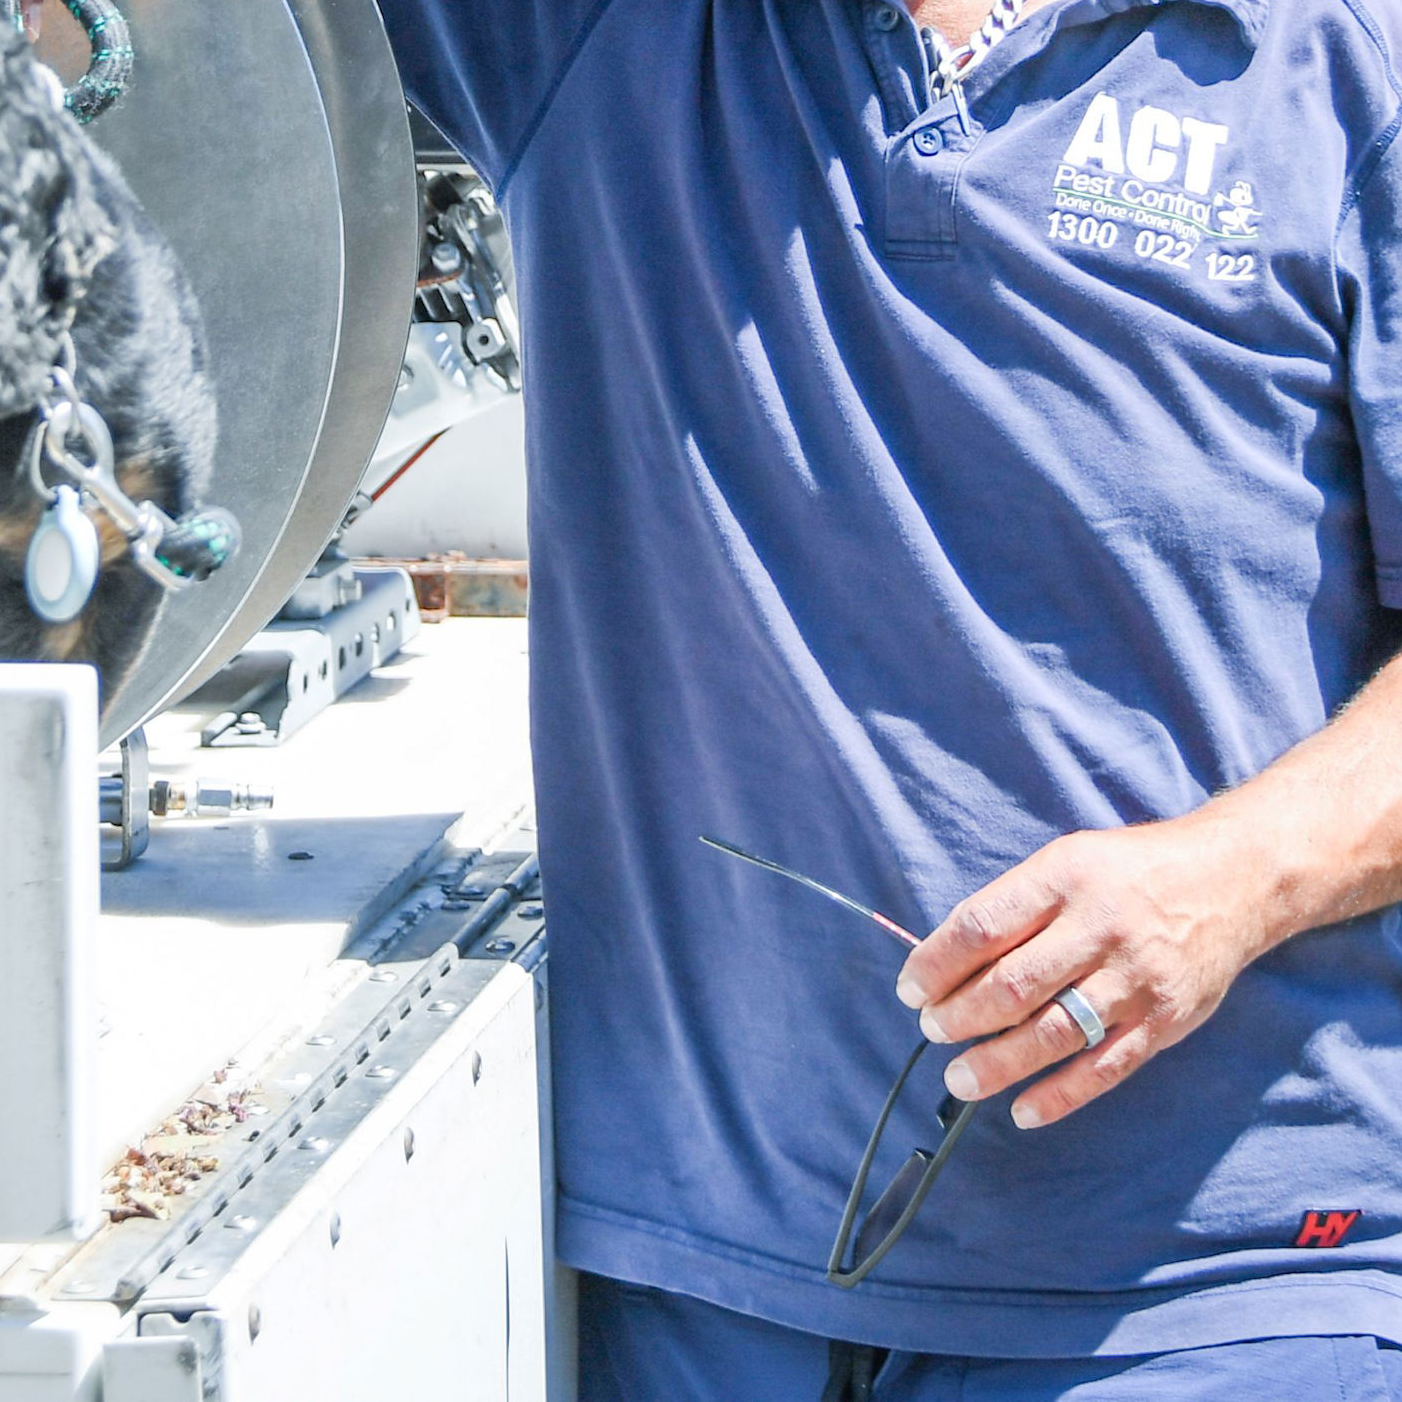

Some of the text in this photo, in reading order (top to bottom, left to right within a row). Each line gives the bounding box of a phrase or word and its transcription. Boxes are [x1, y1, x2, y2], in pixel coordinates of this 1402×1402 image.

[1062, 91, 1229, 195] ACT
[1054, 165, 1212, 225] Pest Control
[1056, 192, 1090, 211] Done
[1092, 198, 1127, 218] Once
[1134, 212, 1170, 230] Done
[1047, 210, 1255, 281] 1300 022 122
